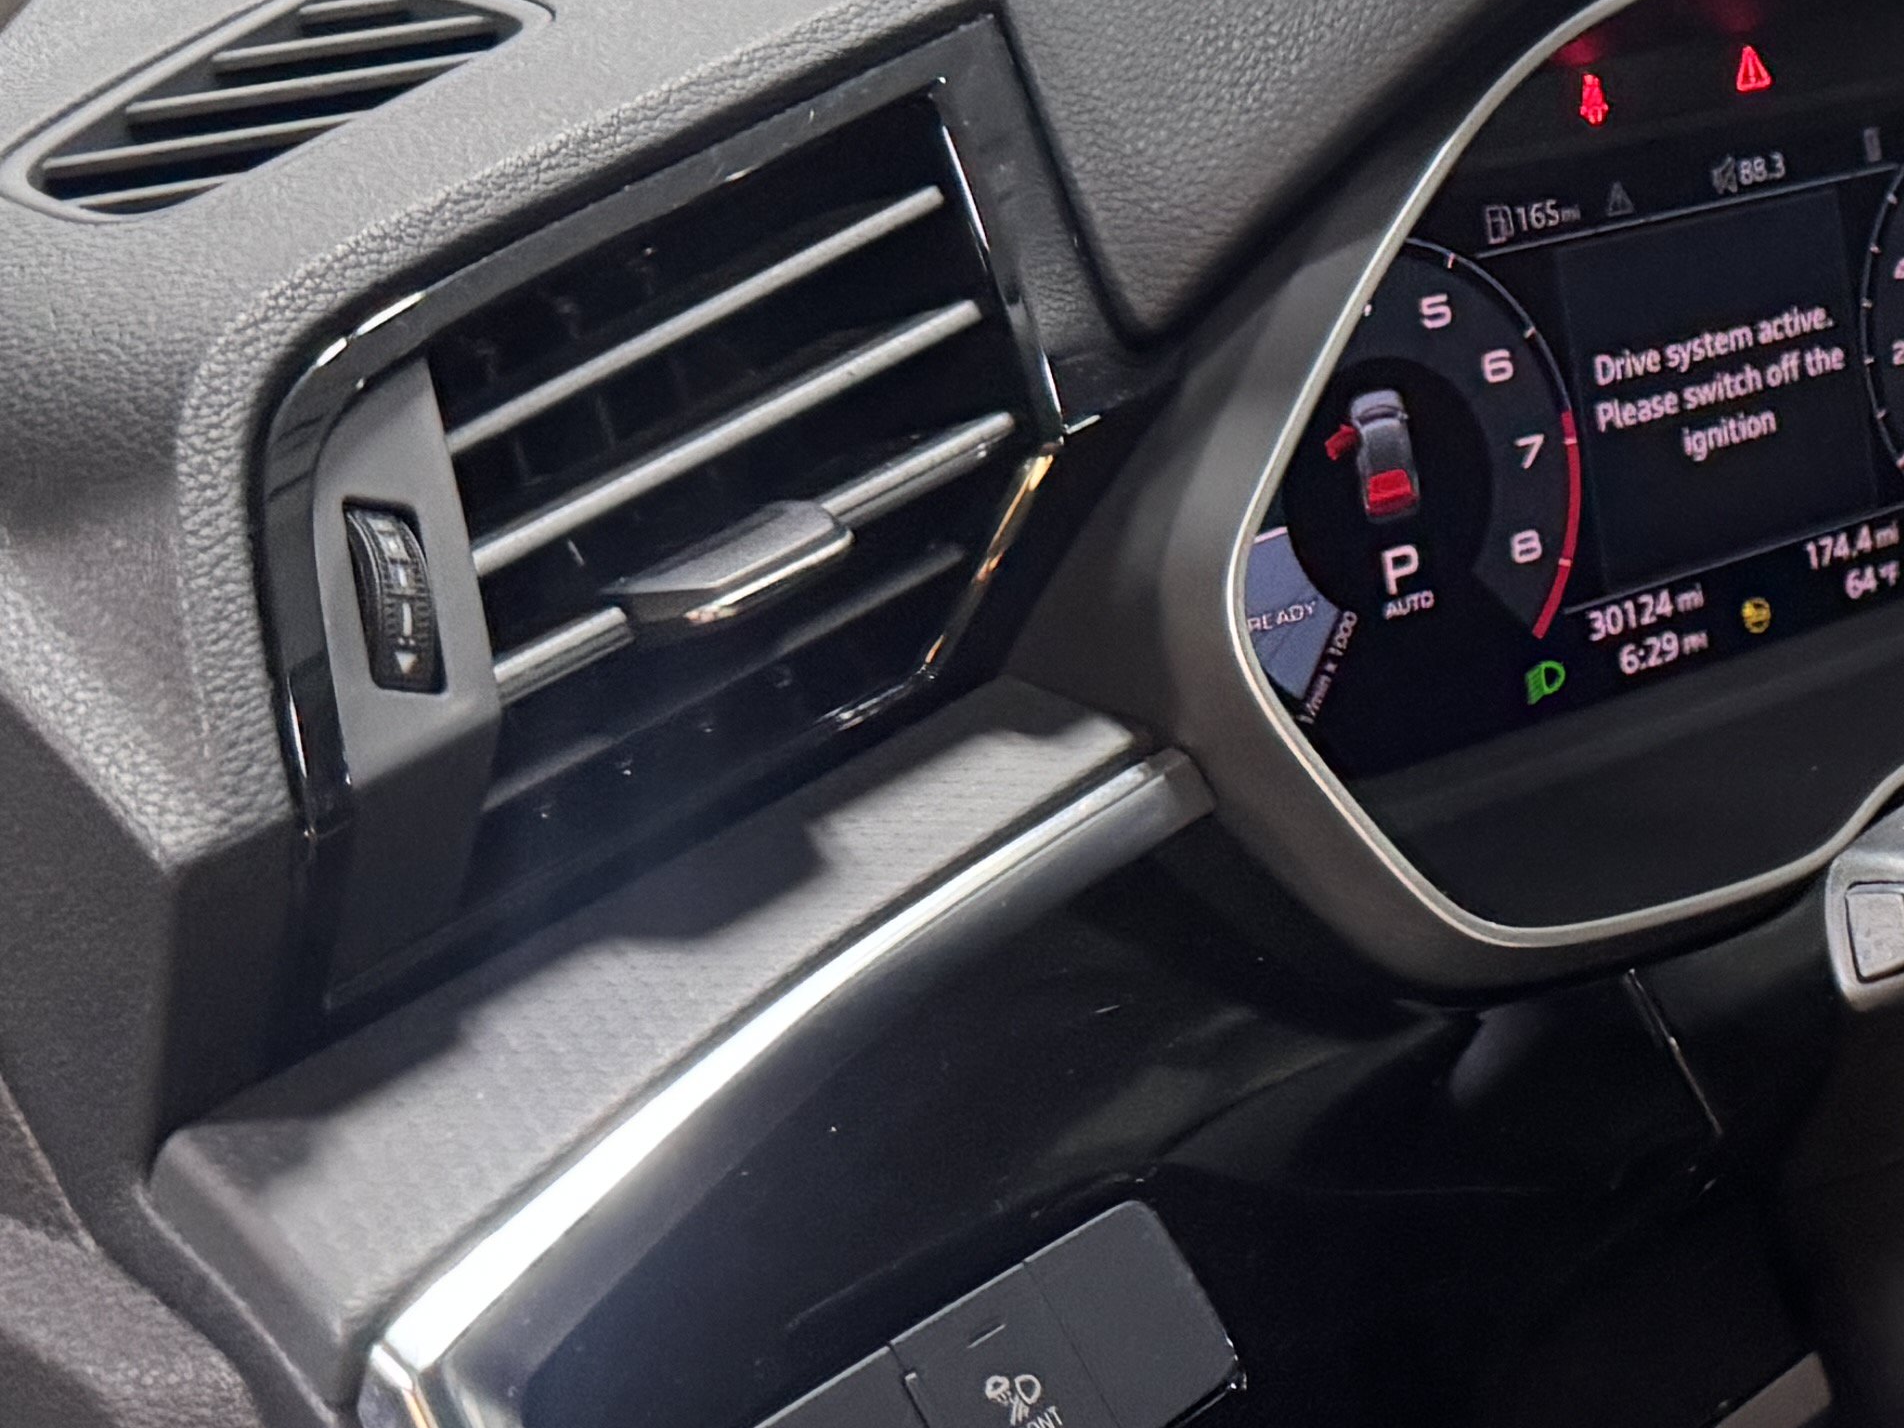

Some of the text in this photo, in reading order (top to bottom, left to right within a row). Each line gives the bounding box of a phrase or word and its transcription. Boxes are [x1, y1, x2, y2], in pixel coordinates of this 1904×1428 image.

[1738, 152, 1786, 185] 88.3
[1419, 293, 1452, 329] 5
[1481, 348, 1514, 383] 6
[1594, 305, 1835, 386] Drive system active.
[1596, 346, 1845, 432] Please switch off the
[1514, 434, 1544, 469] 7
[1681, 410, 1777, 462] ignition
[1510, 529, 1543, 565] 8
[1805, 520, 1899, 570] 174.4 mi
[1381, 544, 1419, 595] P
[1844, 565, 1878, 599] 64
[1247, 600, 1316, 632] READY
[1384, 590, 1435, 620] AUTO
[1587, 582, 1704, 642] 30124 mi
[1328, 611, 1358, 656] 1000
[1618, 631, 1680, 675] 6:29
